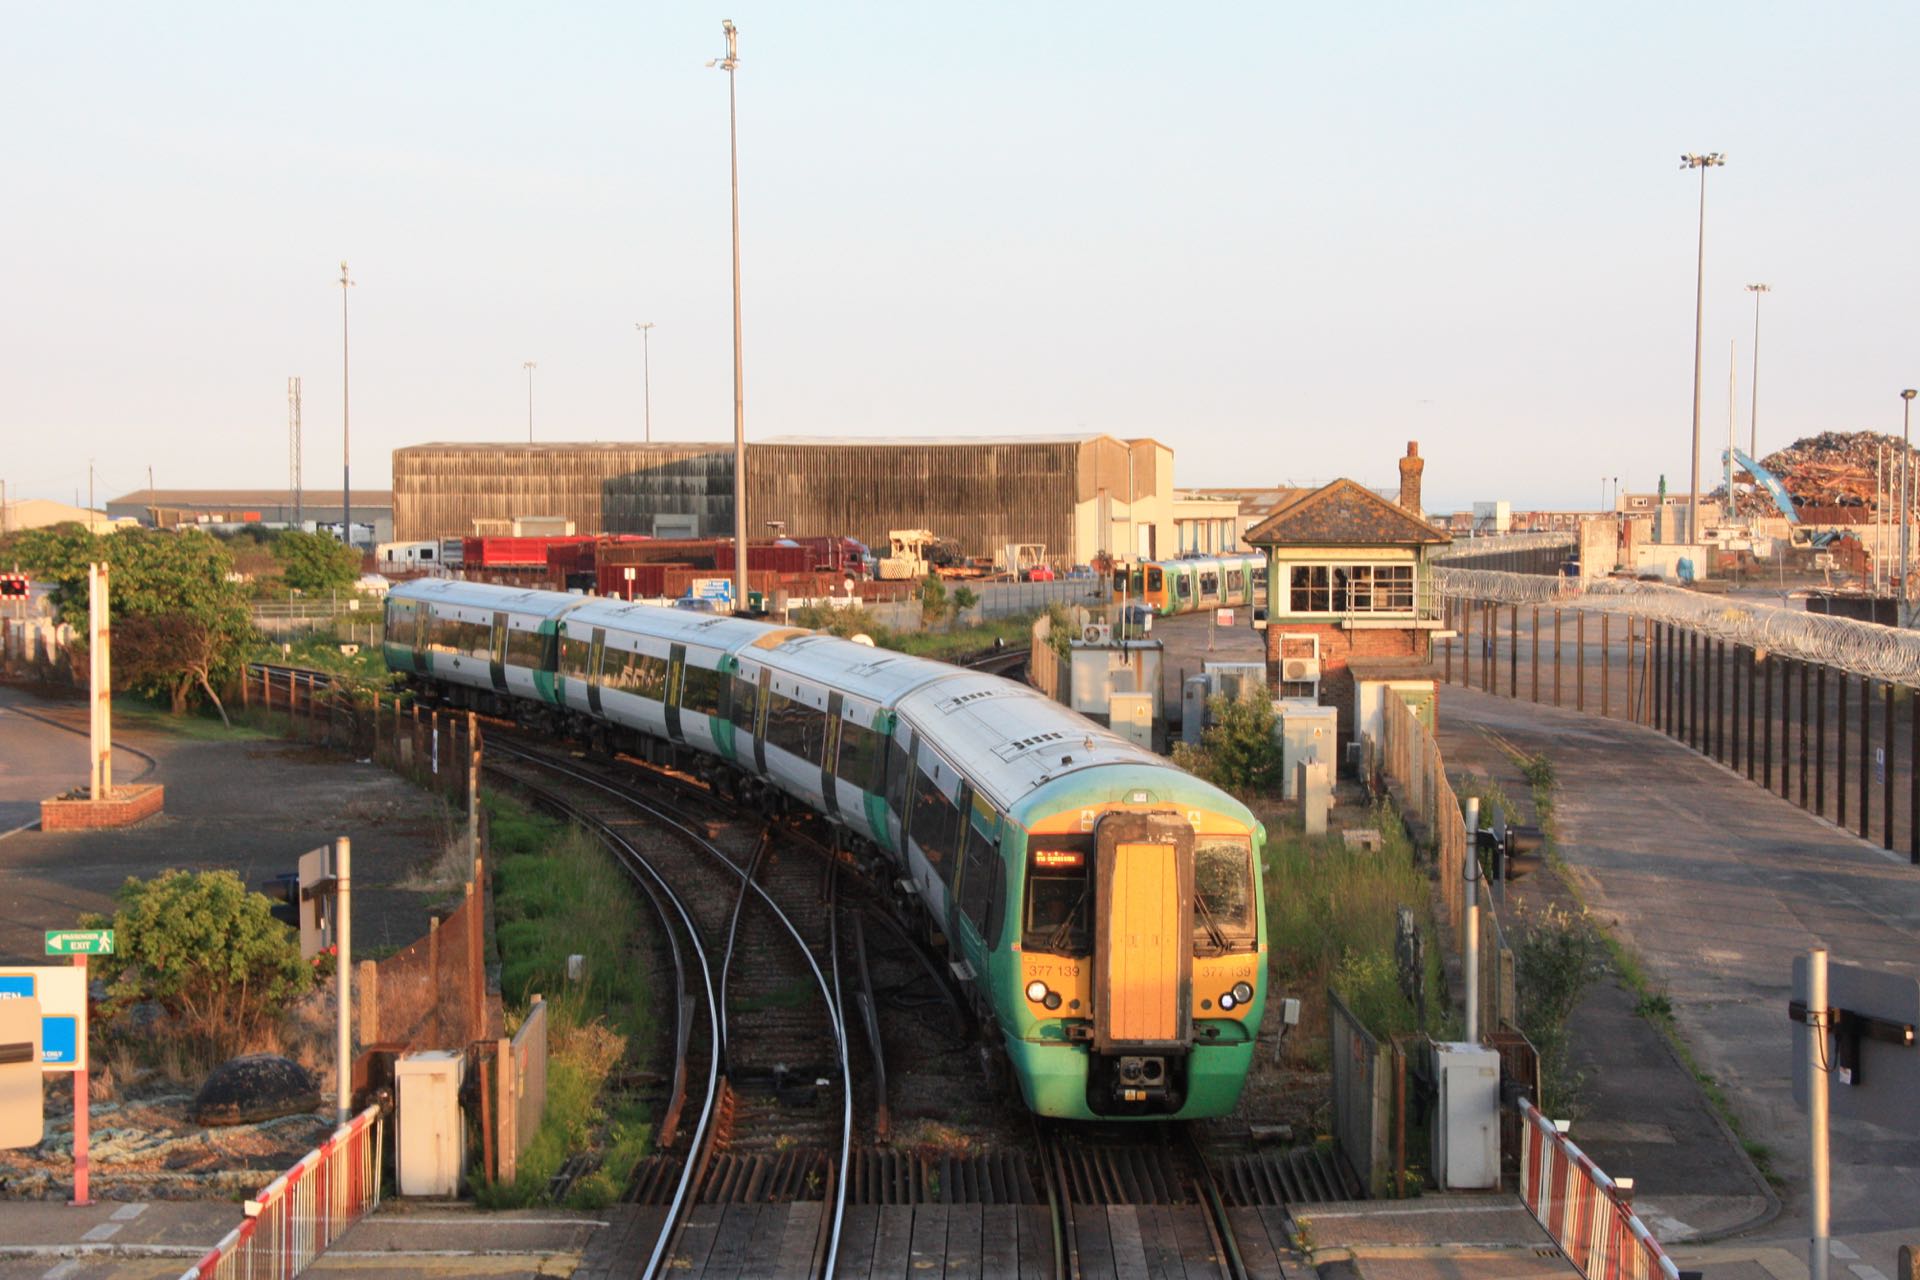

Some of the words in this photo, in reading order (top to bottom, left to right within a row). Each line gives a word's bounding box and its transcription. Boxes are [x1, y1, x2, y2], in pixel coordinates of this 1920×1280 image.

[71, 941, 90, 950] EXIT
[1029, 966, 1052, 976] 377
[1059, 966, 1080, 976] 139
[1203, 966, 1224, 977] 377
[1231, 966, 1251, 977] 139
